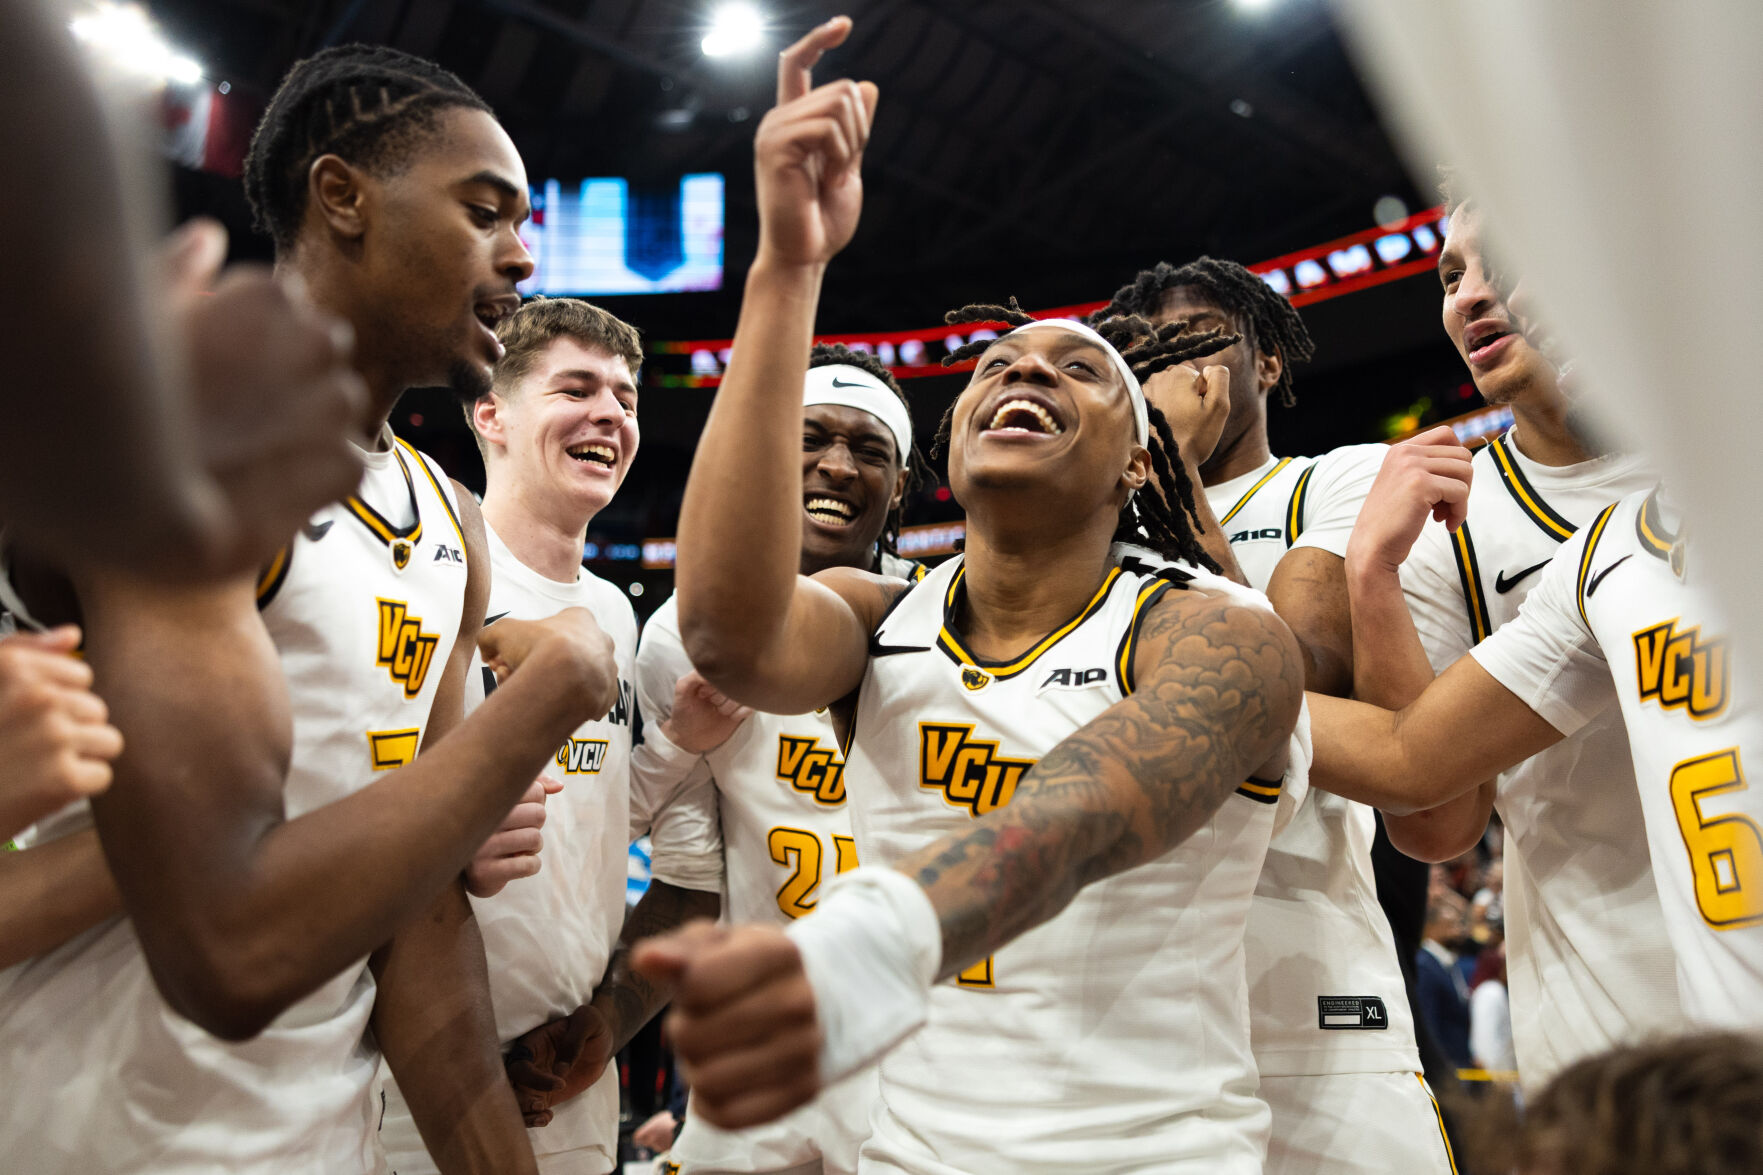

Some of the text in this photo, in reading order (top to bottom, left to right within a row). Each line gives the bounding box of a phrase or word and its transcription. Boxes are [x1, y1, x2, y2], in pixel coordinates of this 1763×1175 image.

[1229, 528, 1282, 544] A10
[376, 597, 441, 699] VCU
[1040, 667, 1107, 689] A10
[1631, 616, 1733, 721] VCU
[565, 737, 610, 775] VCU
[776, 733, 847, 806] VCU
[918, 721, 1040, 818] VCU
[1669, 745, 1763, 931] 6
[1366, 1006, 1382, 1020] XL
